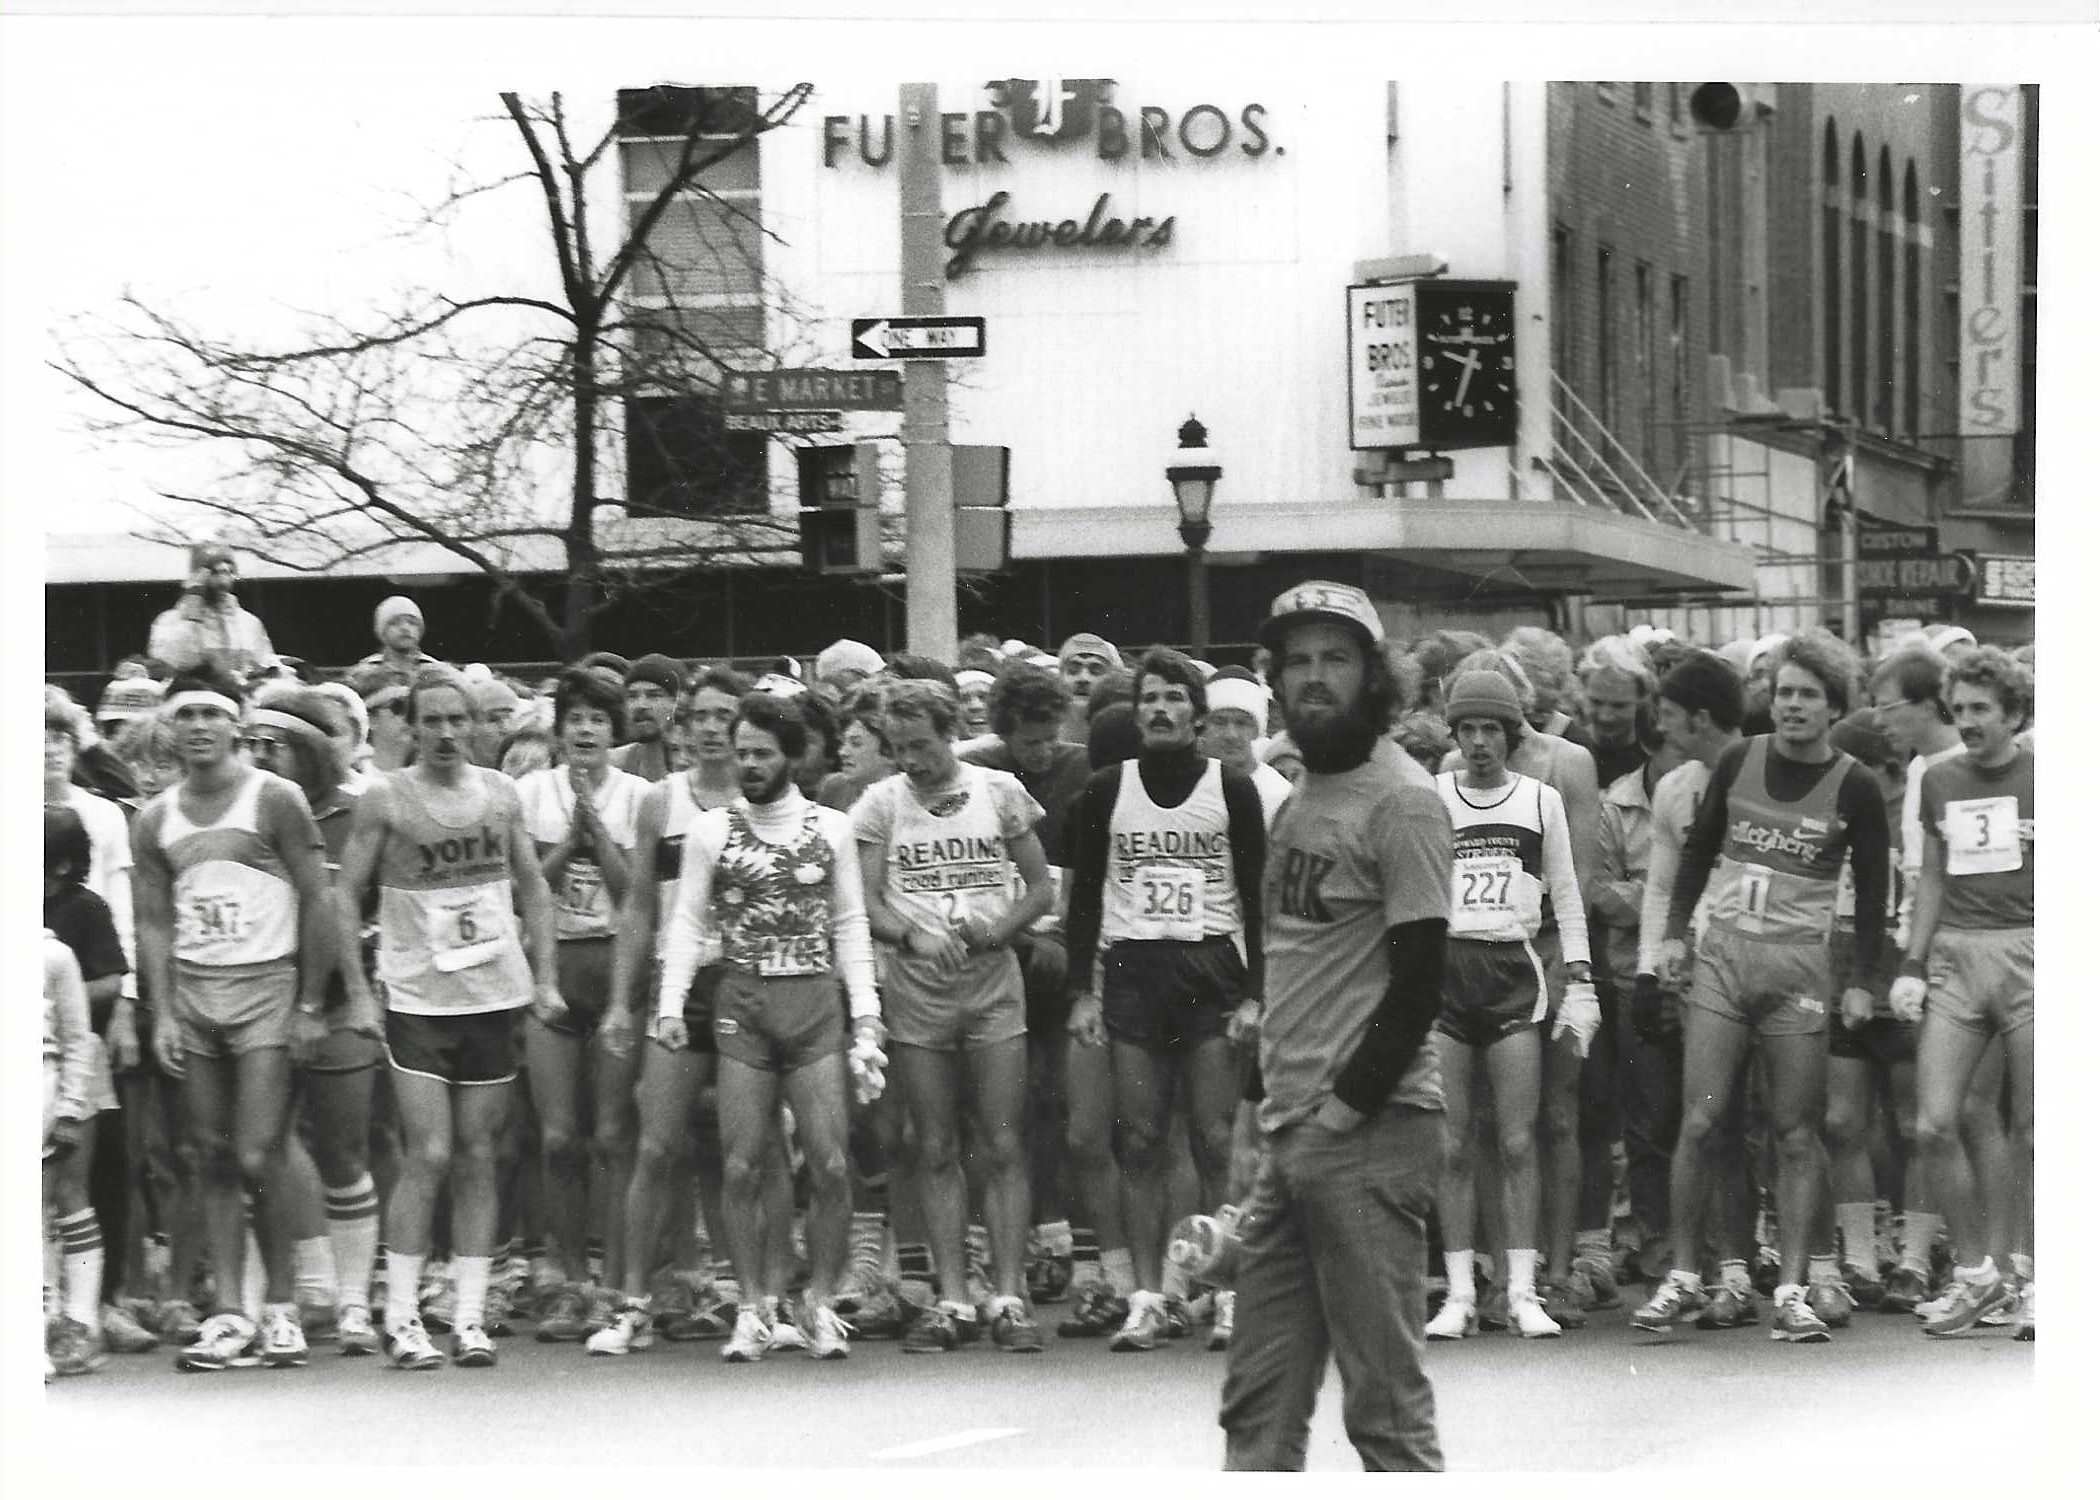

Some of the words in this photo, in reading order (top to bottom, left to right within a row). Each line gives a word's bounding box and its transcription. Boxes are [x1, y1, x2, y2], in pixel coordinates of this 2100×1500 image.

[823, 110, 1008, 168] FUER
[1096, 103, 1287, 162] BROS.
[944, 190, 1176, 280] Jewelers
[881, 328, 914, 348] ONE
[779, 372, 876, 402] MARKET
[1117, 831, 1224, 854] READING
[1976, 812, 1989, 847] 3
[418, 826, 506, 872] york
[1142, 881, 1193, 915] 326
[1462, 871, 1512, 905] 227
[941, 891, 965, 925] 2
[459, 911, 477, 941] 6
